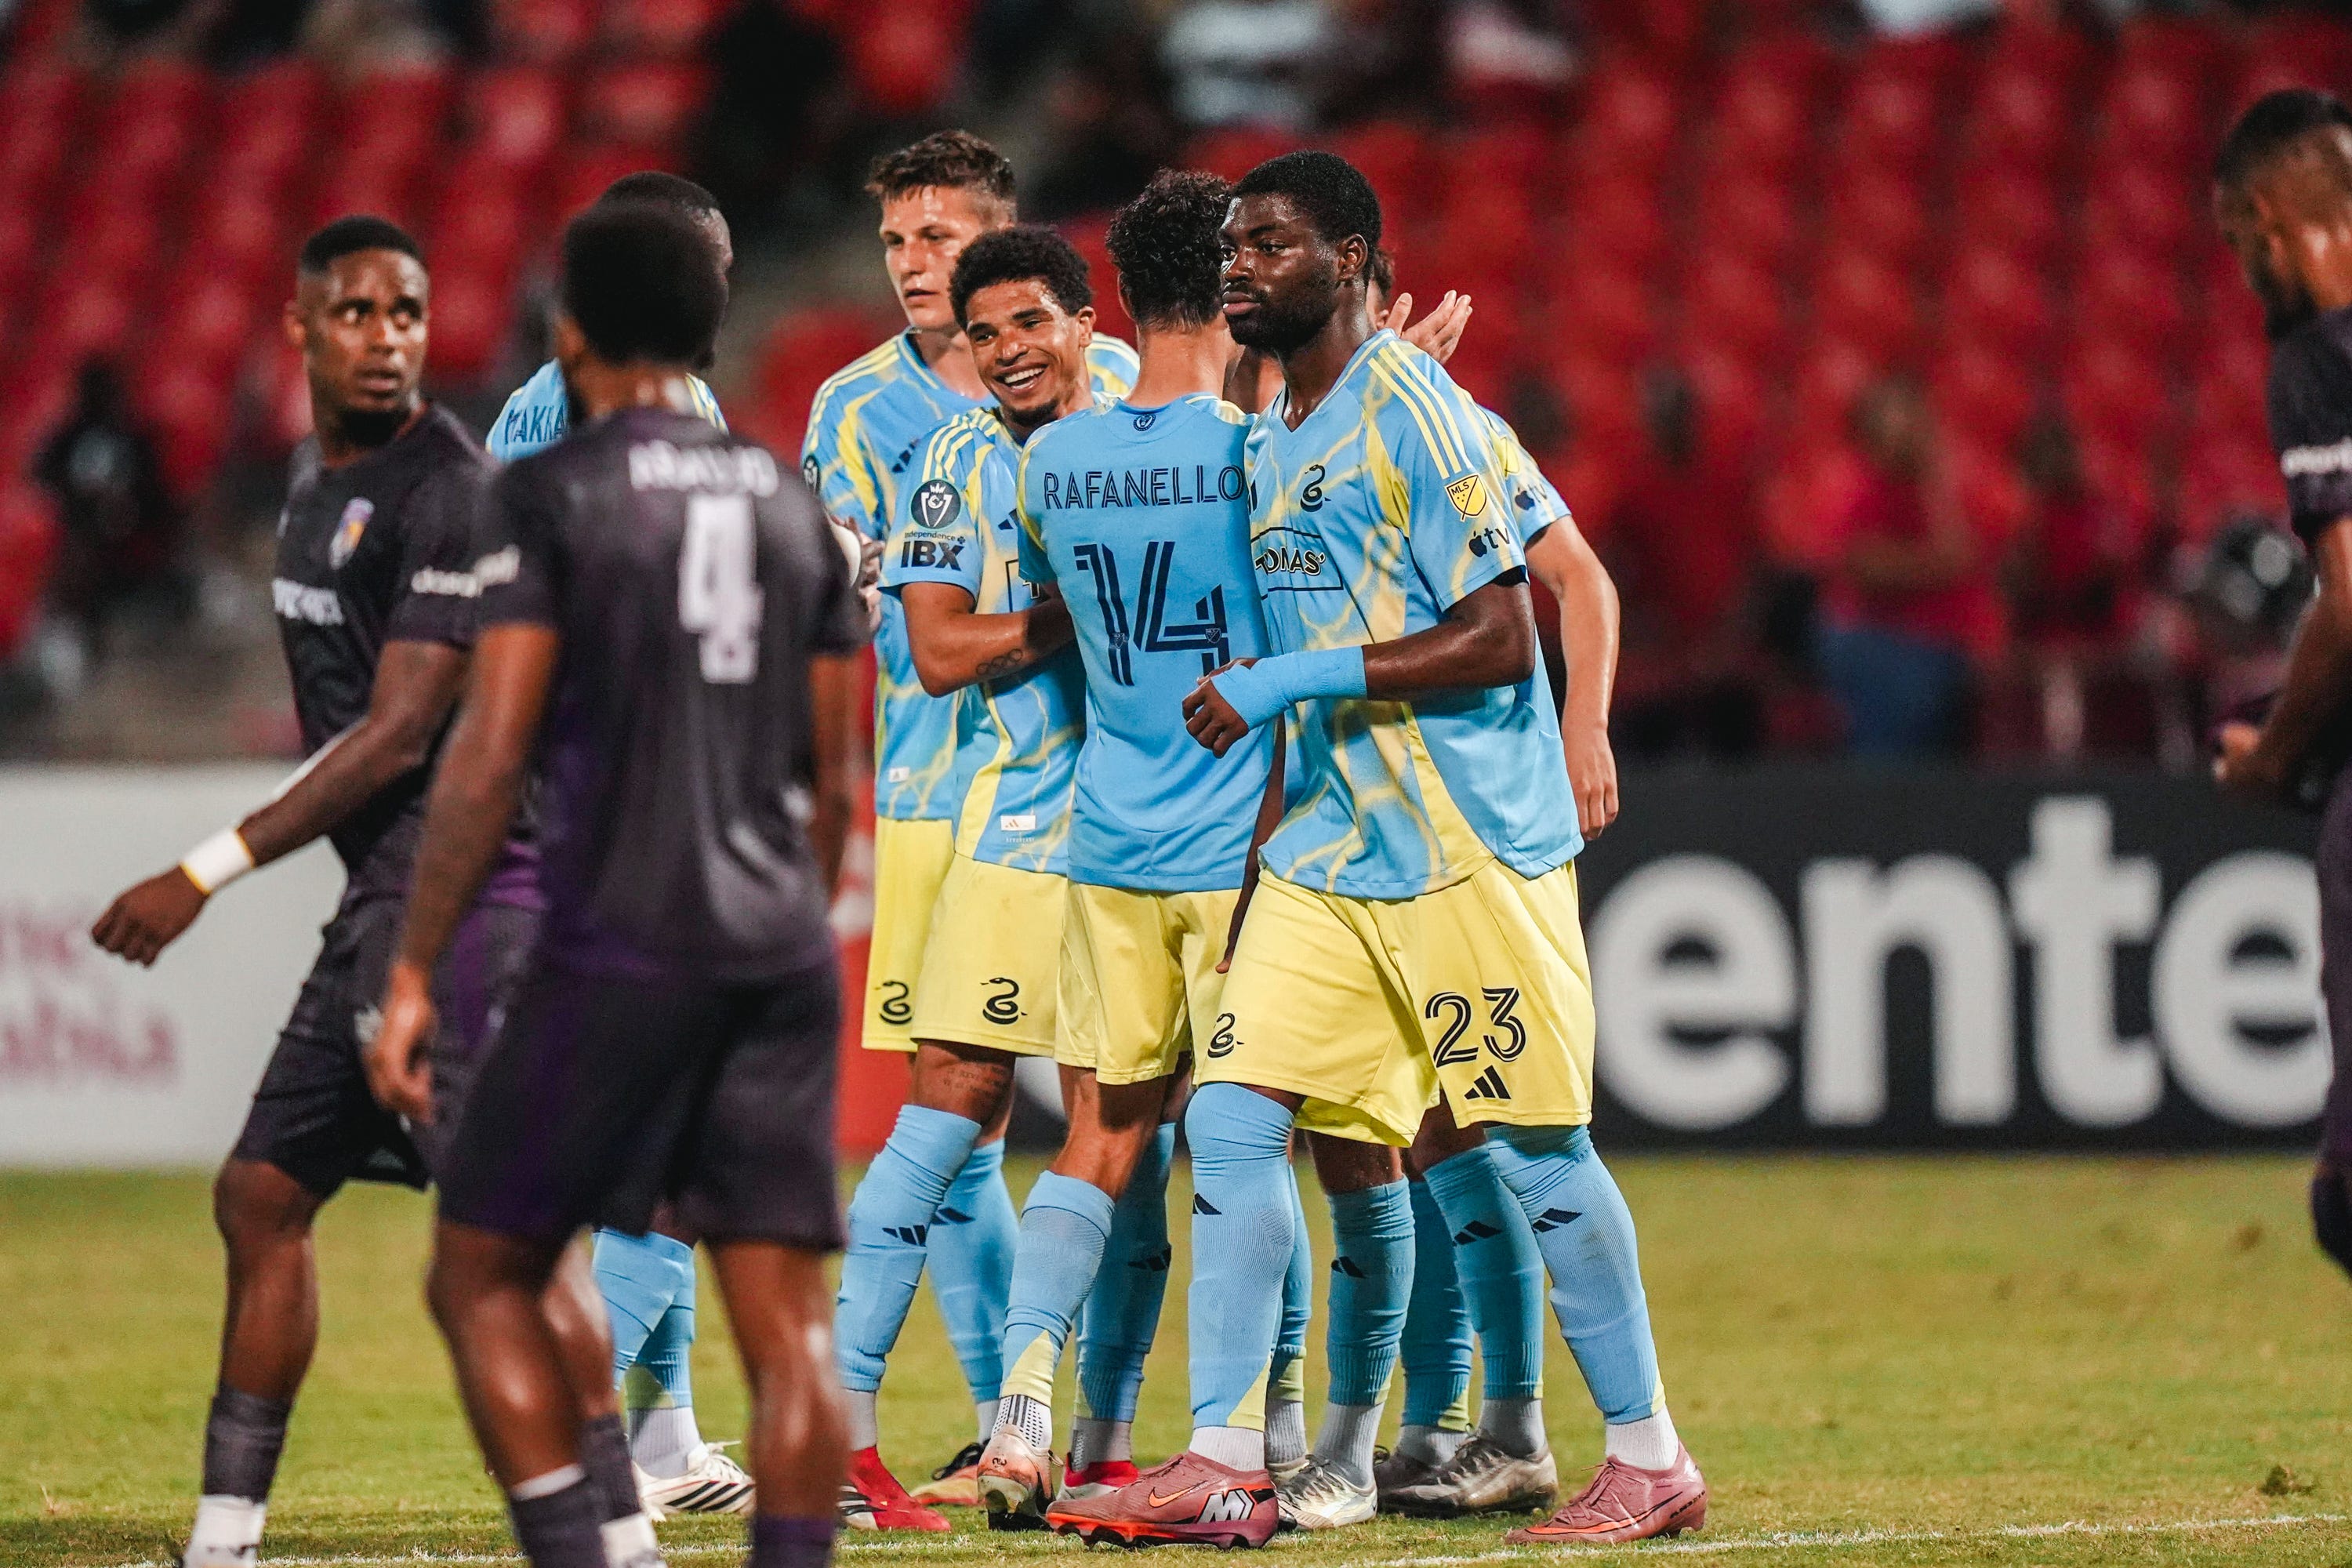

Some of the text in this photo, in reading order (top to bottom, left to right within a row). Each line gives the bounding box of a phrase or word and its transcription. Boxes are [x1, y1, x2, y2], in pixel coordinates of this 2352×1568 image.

[1044, 464, 1244, 510] RAFANELLO
[1450, 481, 1470, 495] MLS
[677, 492, 767, 684] 4
[900, 540, 965, 572] IBX
[1074, 540, 1231, 687] 14
[1590, 793, 2333, 1131] ente
[1425, 985, 1526, 1068] 23
